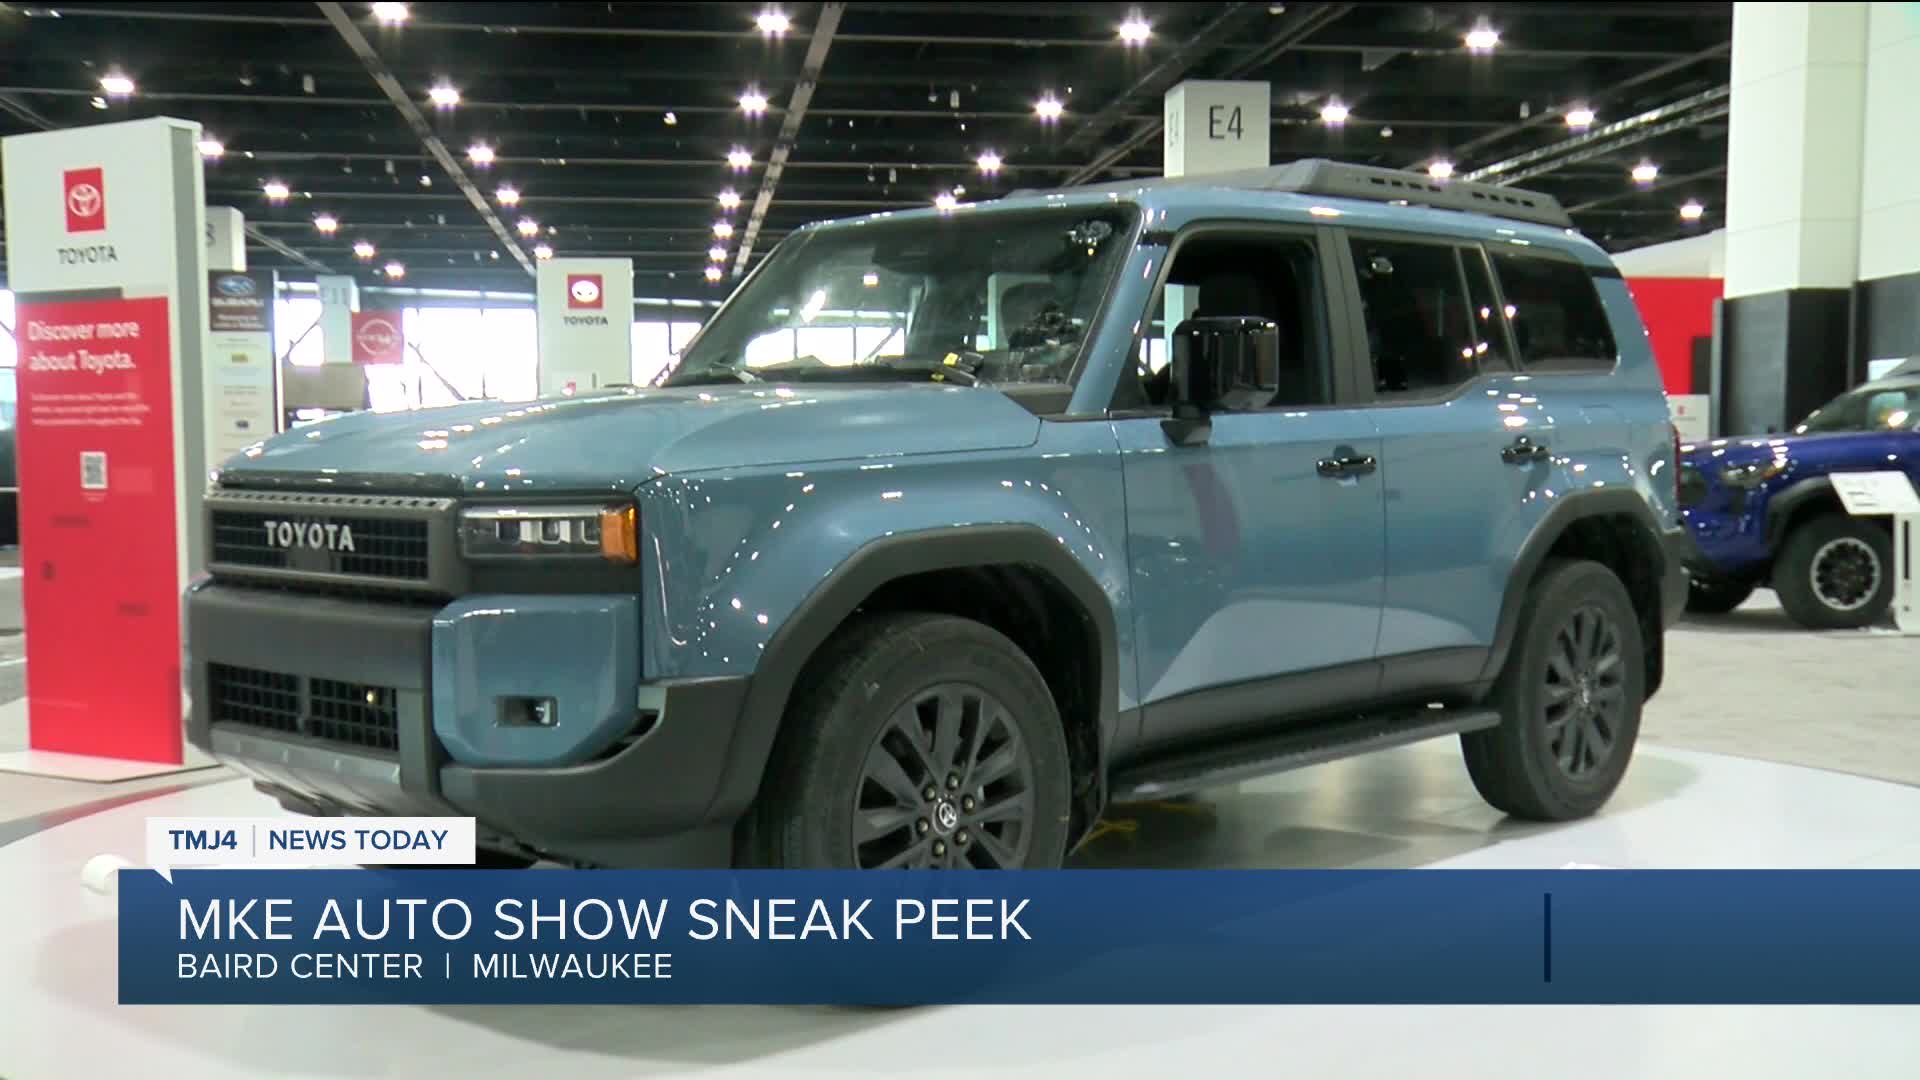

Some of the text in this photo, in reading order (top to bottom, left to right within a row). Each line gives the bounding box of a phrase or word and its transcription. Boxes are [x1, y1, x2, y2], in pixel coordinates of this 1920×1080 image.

[1208, 104, 1244, 140] E4
[57, 246, 118, 264] TOYOTA
[28, 321, 140, 340] Discover more
[564, 316, 609, 325] TOYOTA
[29, 350, 136, 376] about Toyota.
[264, 520, 355, 551] TOYOTA
